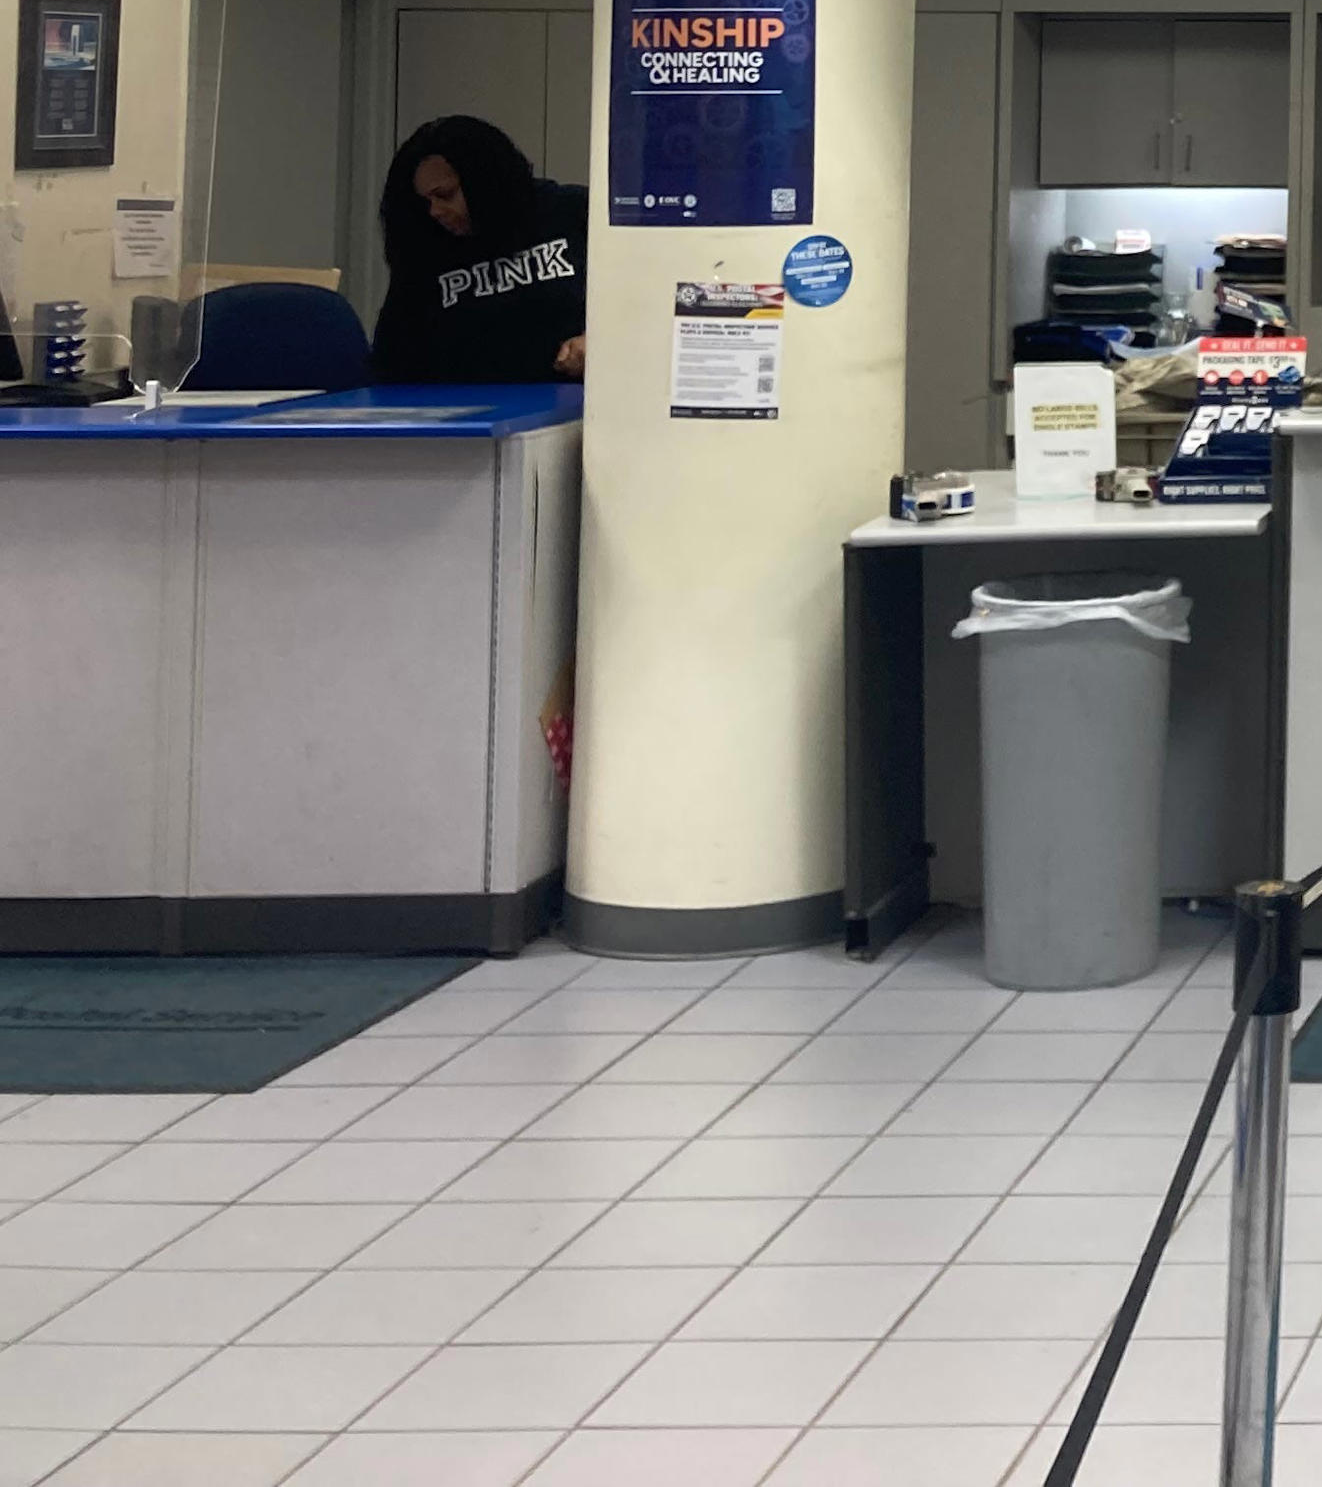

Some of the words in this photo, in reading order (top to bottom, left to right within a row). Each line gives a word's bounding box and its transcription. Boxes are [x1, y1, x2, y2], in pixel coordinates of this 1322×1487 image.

[632, 17, 786, 49] KINSHIP
[641, 51, 764, 69] CONNECTING
[672, 67, 760, 84] HEALING
[438, 238, 575, 308] PINK
[1203, 356, 1244, 365] PACKAGING
[1248, 356, 1265, 365] TAPE
